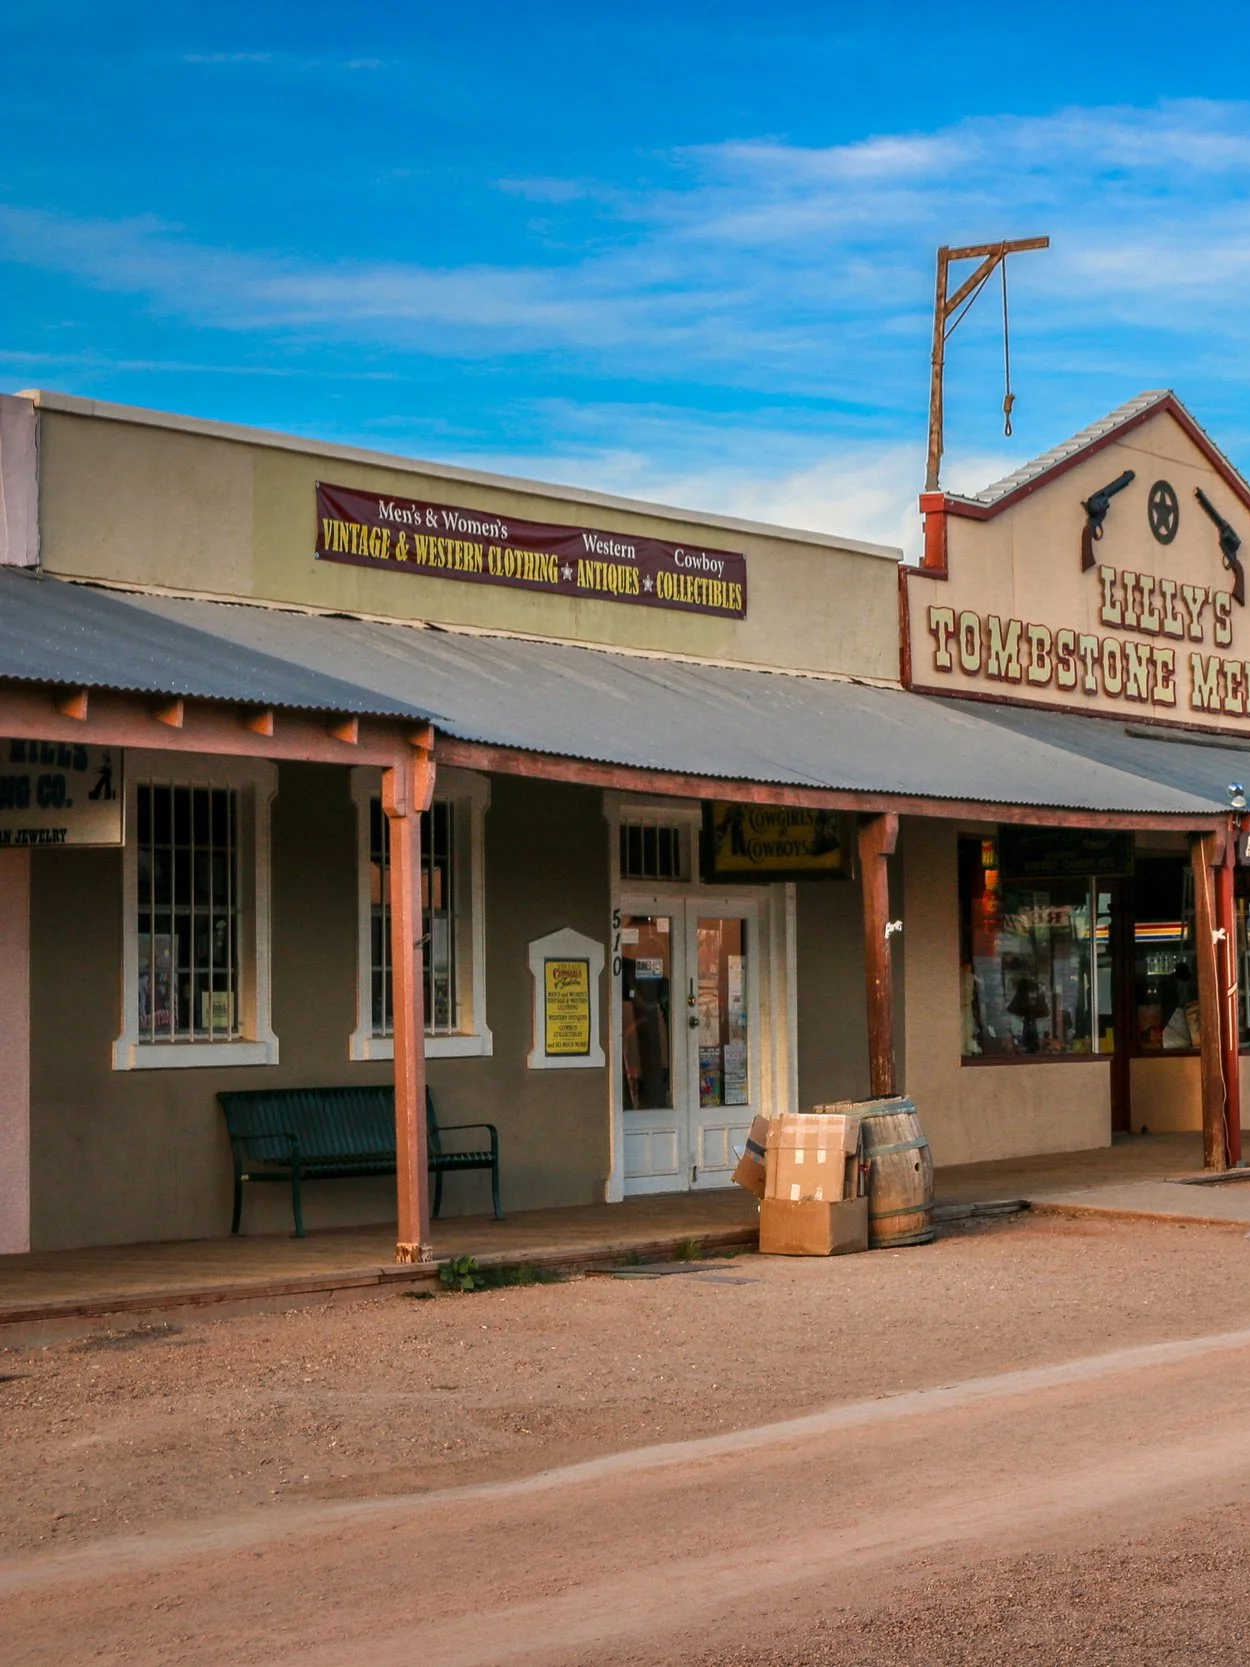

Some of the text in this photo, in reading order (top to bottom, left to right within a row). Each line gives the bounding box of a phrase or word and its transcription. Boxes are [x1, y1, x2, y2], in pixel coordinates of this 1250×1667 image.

[378, 500, 509, 539] Men's & Women's
[322, 518, 742, 611] VINTAGE & WESTERN CLOTHING ANTIQUES COLLECTIBLES
[582, 533, 725, 578] Western Cowboy
[1099, 564, 1234, 649] LILLY'S
[927, 604, 1177, 707] TOMBSTONE
[15, 827, 68, 844] JEWELRY
[748, 808, 815, 834] COWGIRLS
[746, 837, 810, 864] COWBOYS
[612, 908, 623, 977] 510
